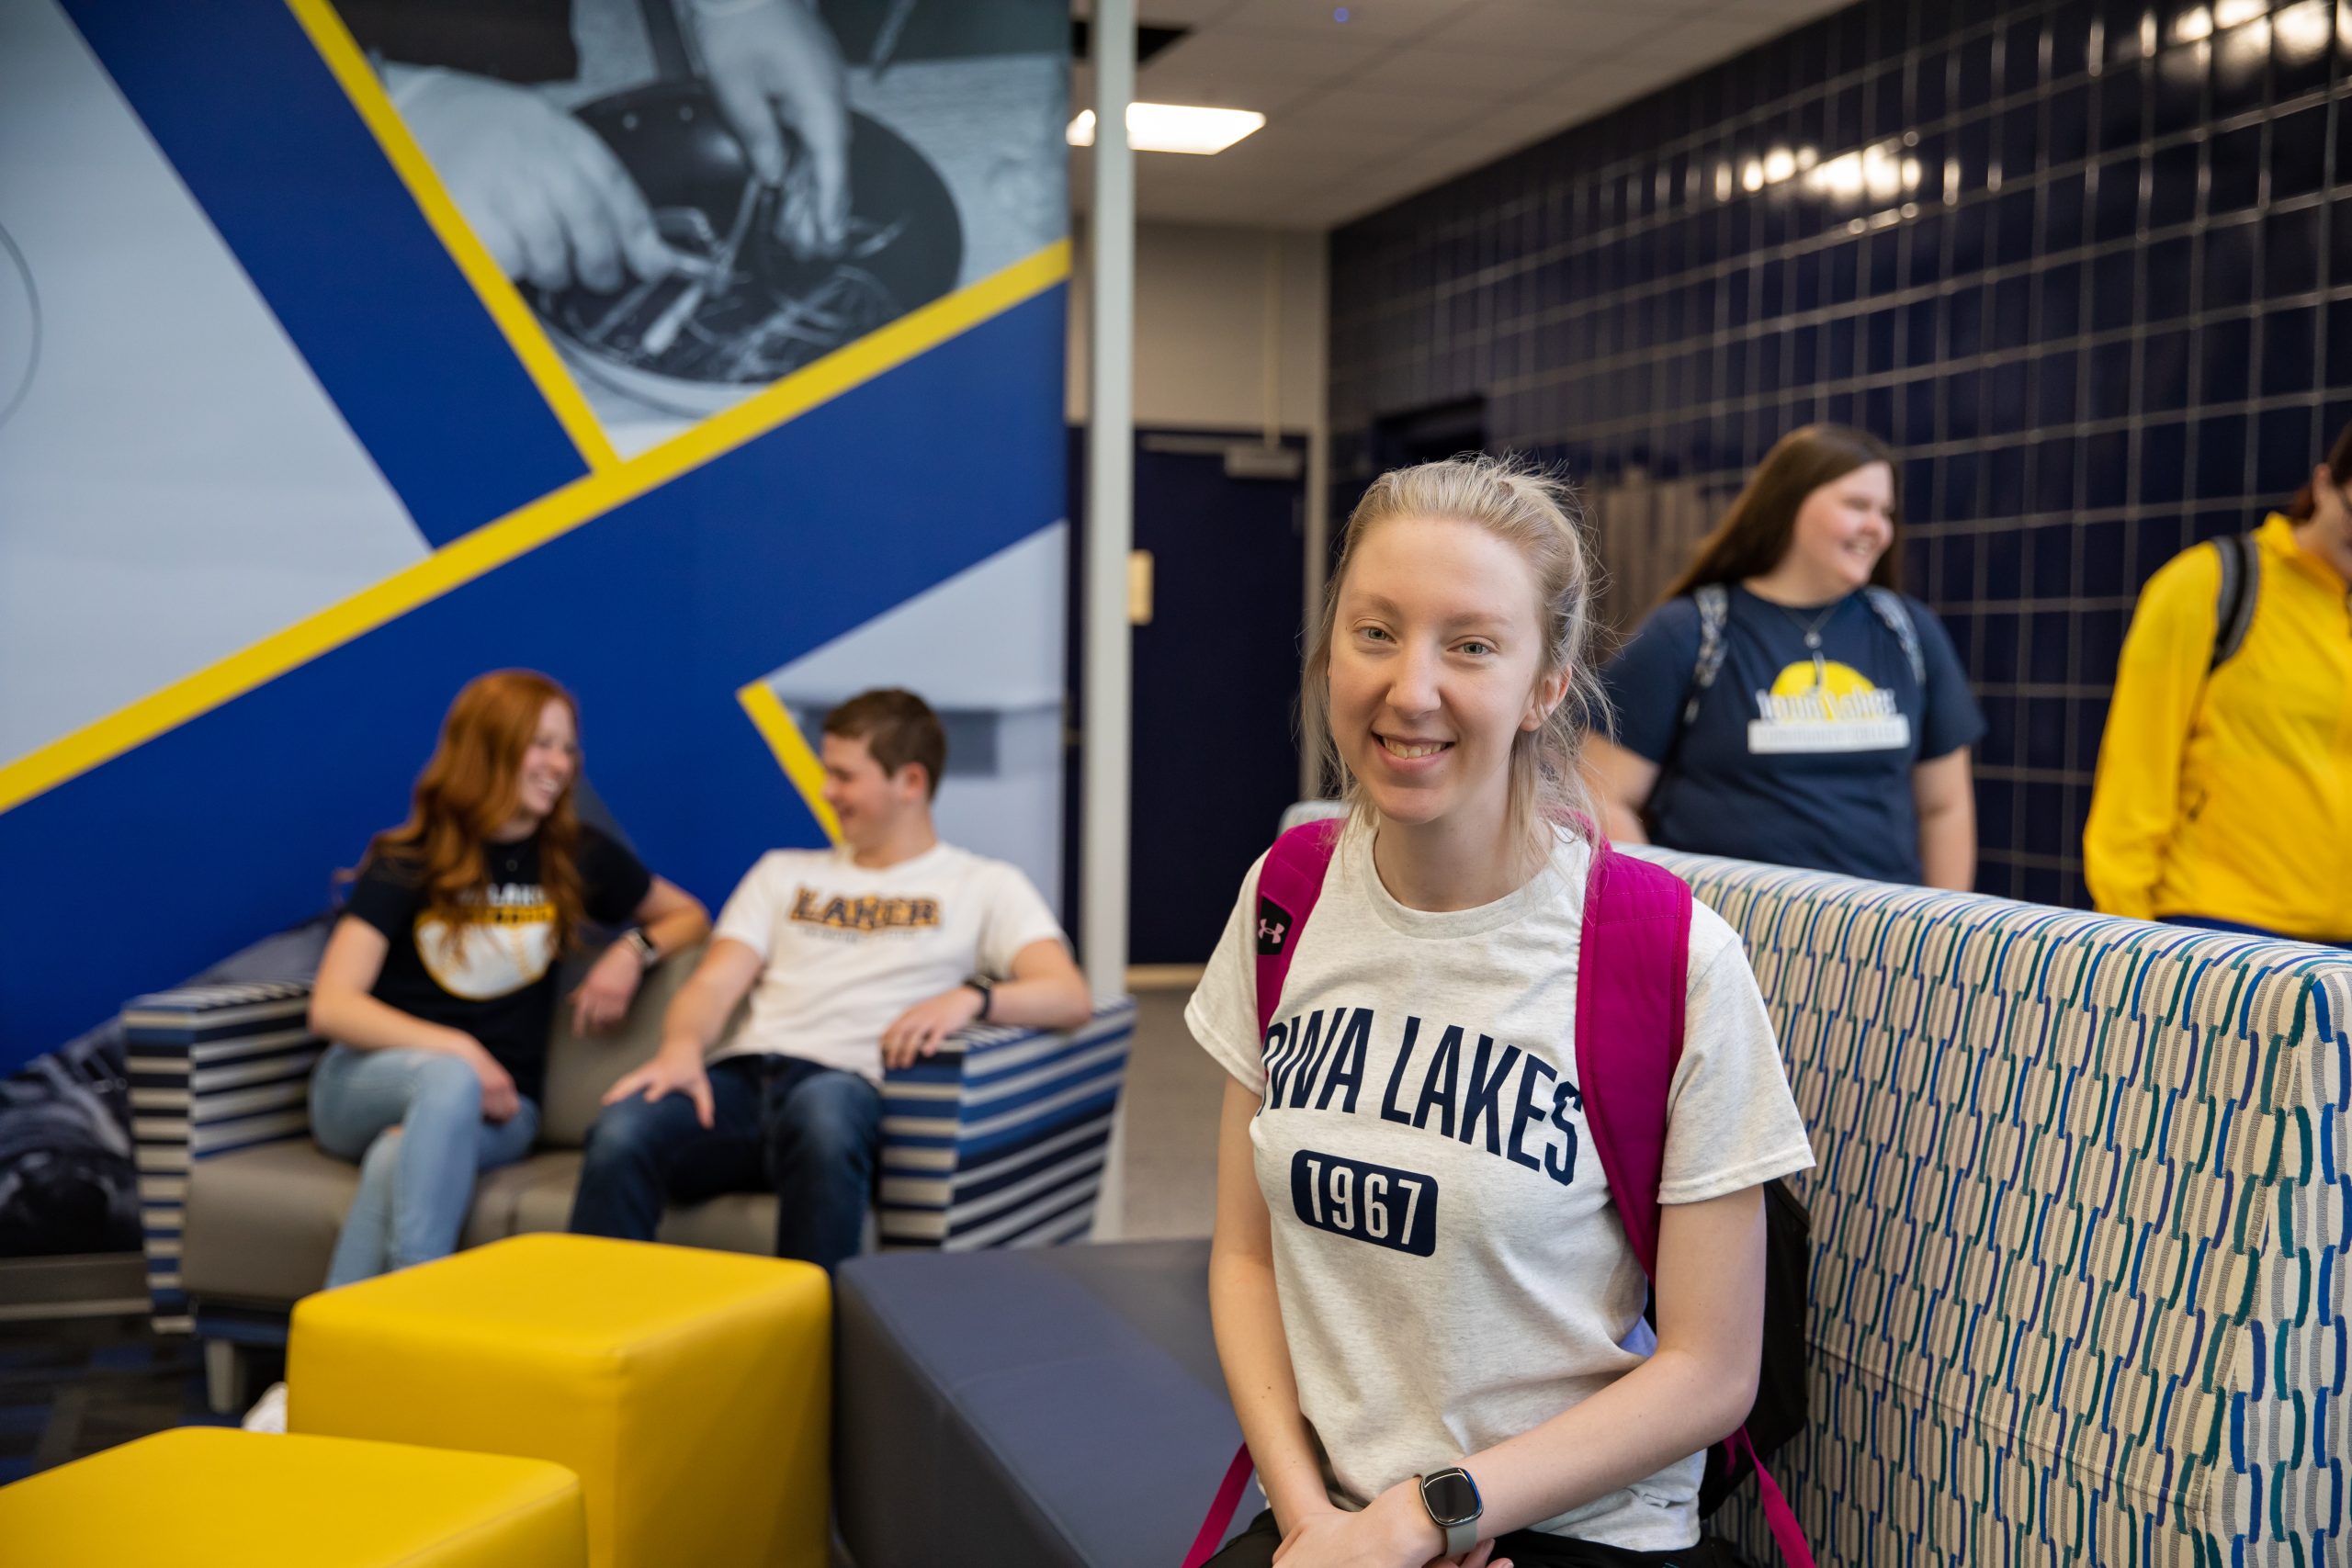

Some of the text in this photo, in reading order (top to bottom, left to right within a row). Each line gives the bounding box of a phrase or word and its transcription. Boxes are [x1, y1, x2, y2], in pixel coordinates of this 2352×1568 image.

[1256, 1007, 1582, 1187] OWA LAKES
[1306, 1157, 1423, 1246] 1967
